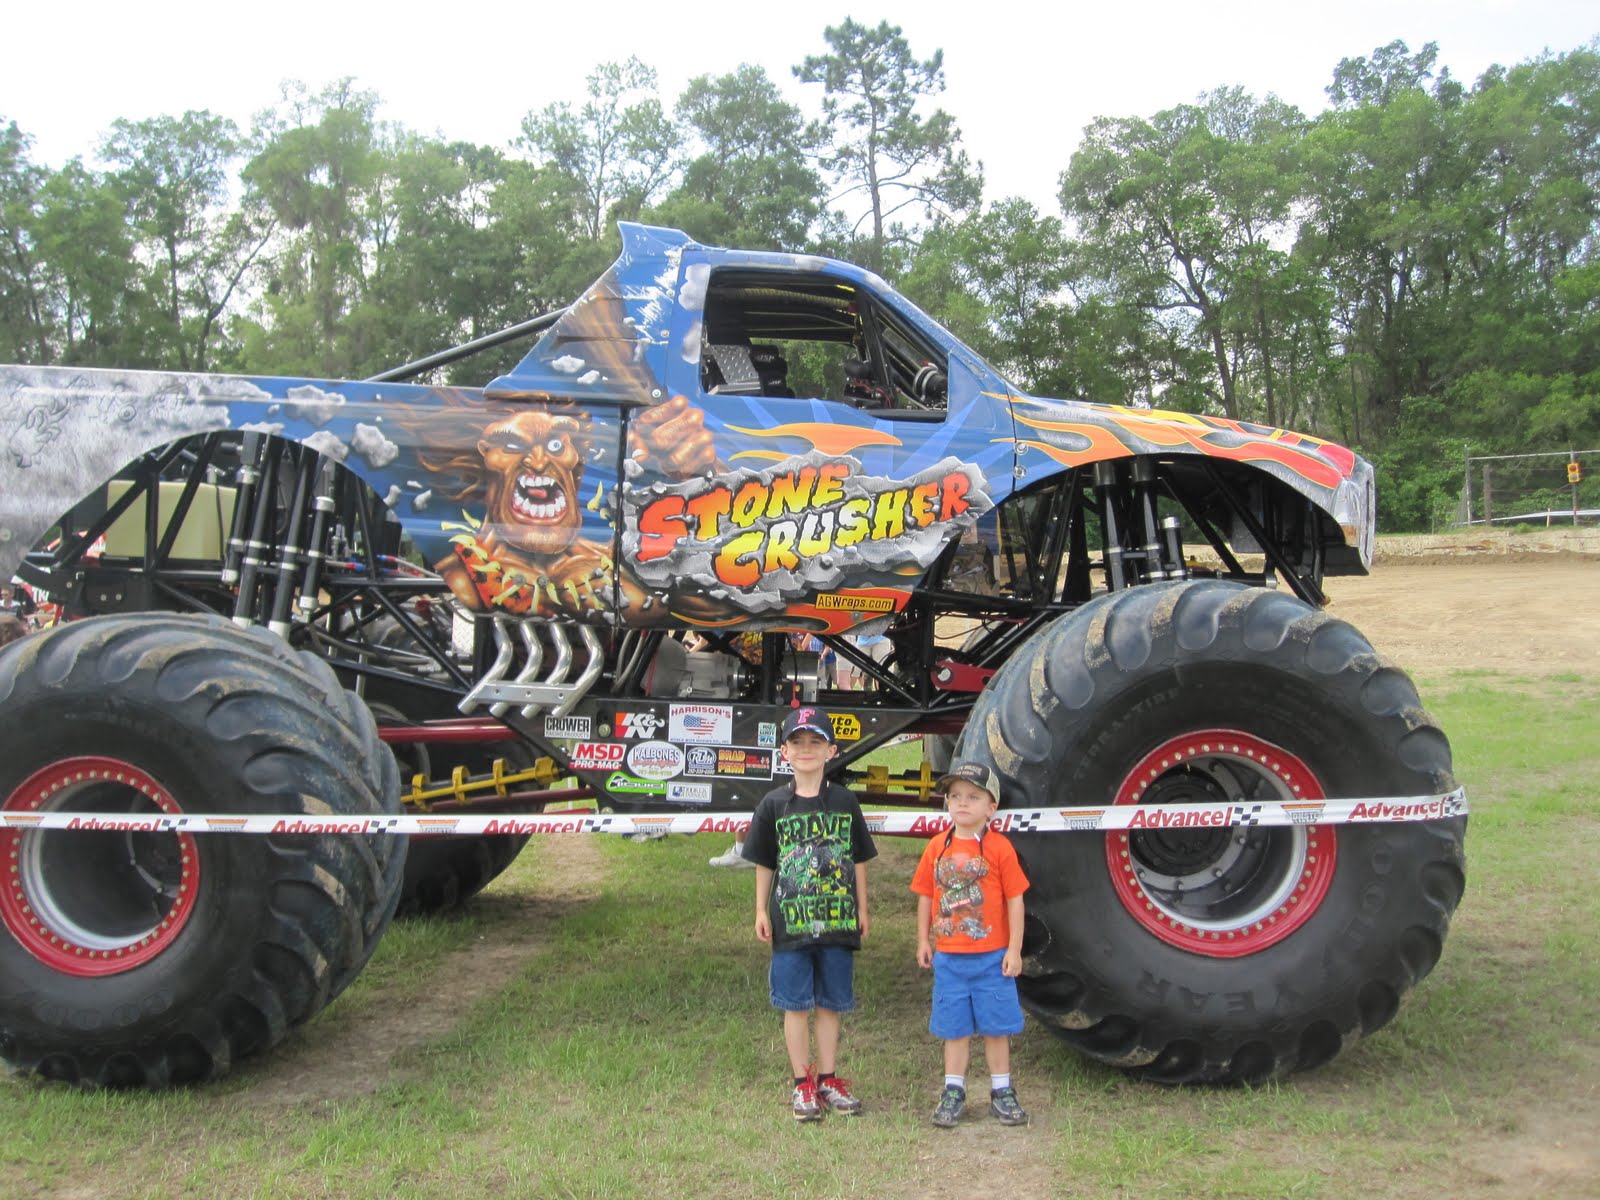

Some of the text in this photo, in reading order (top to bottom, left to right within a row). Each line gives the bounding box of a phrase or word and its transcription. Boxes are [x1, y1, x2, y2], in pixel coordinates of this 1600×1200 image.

[636, 463, 849, 562] STONE
[713, 472, 971, 588] CRUSHER
[817, 595, 894, 611] AGWraps.com
[671, 705, 731, 719] HARRISON'S
[797, 708, 816, 725] F
[546, 717, 589, 732] CROWER
[622, 712, 665, 739] K&N
[830, 717, 853, 727] uto
[835, 727, 858, 736] ter
[576, 743, 623, 760] MSD
[696, 817, 752, 833] Adva
[776, 811, 853, 849] GRAVE
